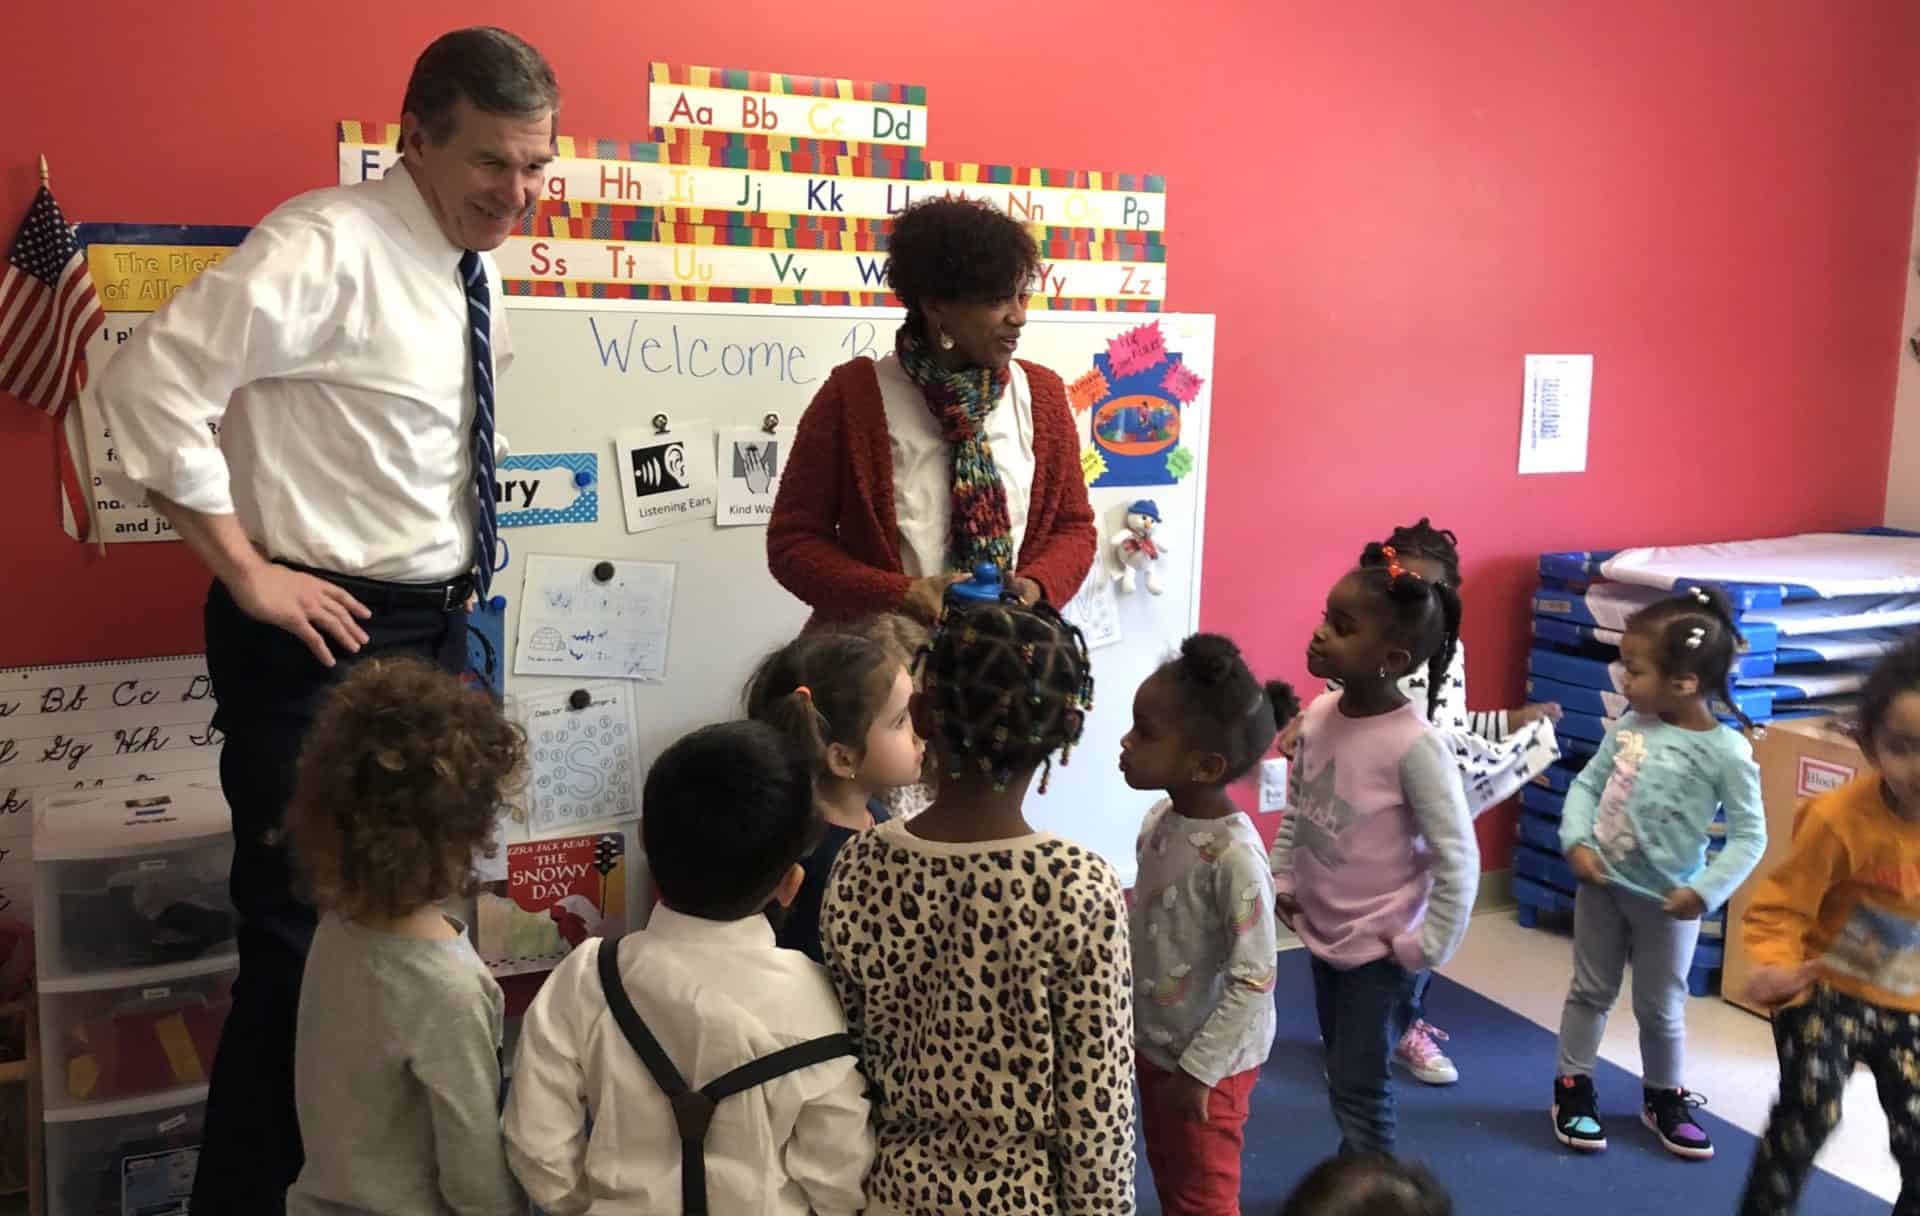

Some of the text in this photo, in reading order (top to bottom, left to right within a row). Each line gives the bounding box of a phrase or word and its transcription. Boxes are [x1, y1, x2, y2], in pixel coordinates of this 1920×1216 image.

[669, 92, 911, 141] Aa Bb Cc Dd
[600, 165, 642, 201] Hh
[668, 170, 694, 204] Ii
[736, 174, 762, 212] Jj
[807, 178, 844, 212] Kk
[886, 184, 910, 215] Ll
[1007, 191, 1044, 220] Nn
[1123, 197, 1150, 230] Pp
[114, 252, 159, 273] The
[530, 243, 567, 277] Ss
[606, 246, 636, 279] Tt
[674, 247, 713, 281] Uu
[770, 252, 808, 284] Vv
[1036, 263, 1067, 297] Yy
[1119, 266, 1152, 295] Zz
[104, 279, 129, 299] of
[588, 317, 817, 385] Welcome
[639, 497, 712, 518] Listening Ears
[729, 504, 752, 514] Kind
[115, 517, 176, 535] and ju
[40, 684, 88, 714] Bb
[112, 680, 160, 706] Cc
[114, 726, 170, 754] Hh
[536, 843, 559, 853] JACK
[562, 839, 591, 850] KEATS
[534, 853, 567, 866] THE
[512, 863, 590, 886] SNOWY
[532, 881, 574, 900] DAY
